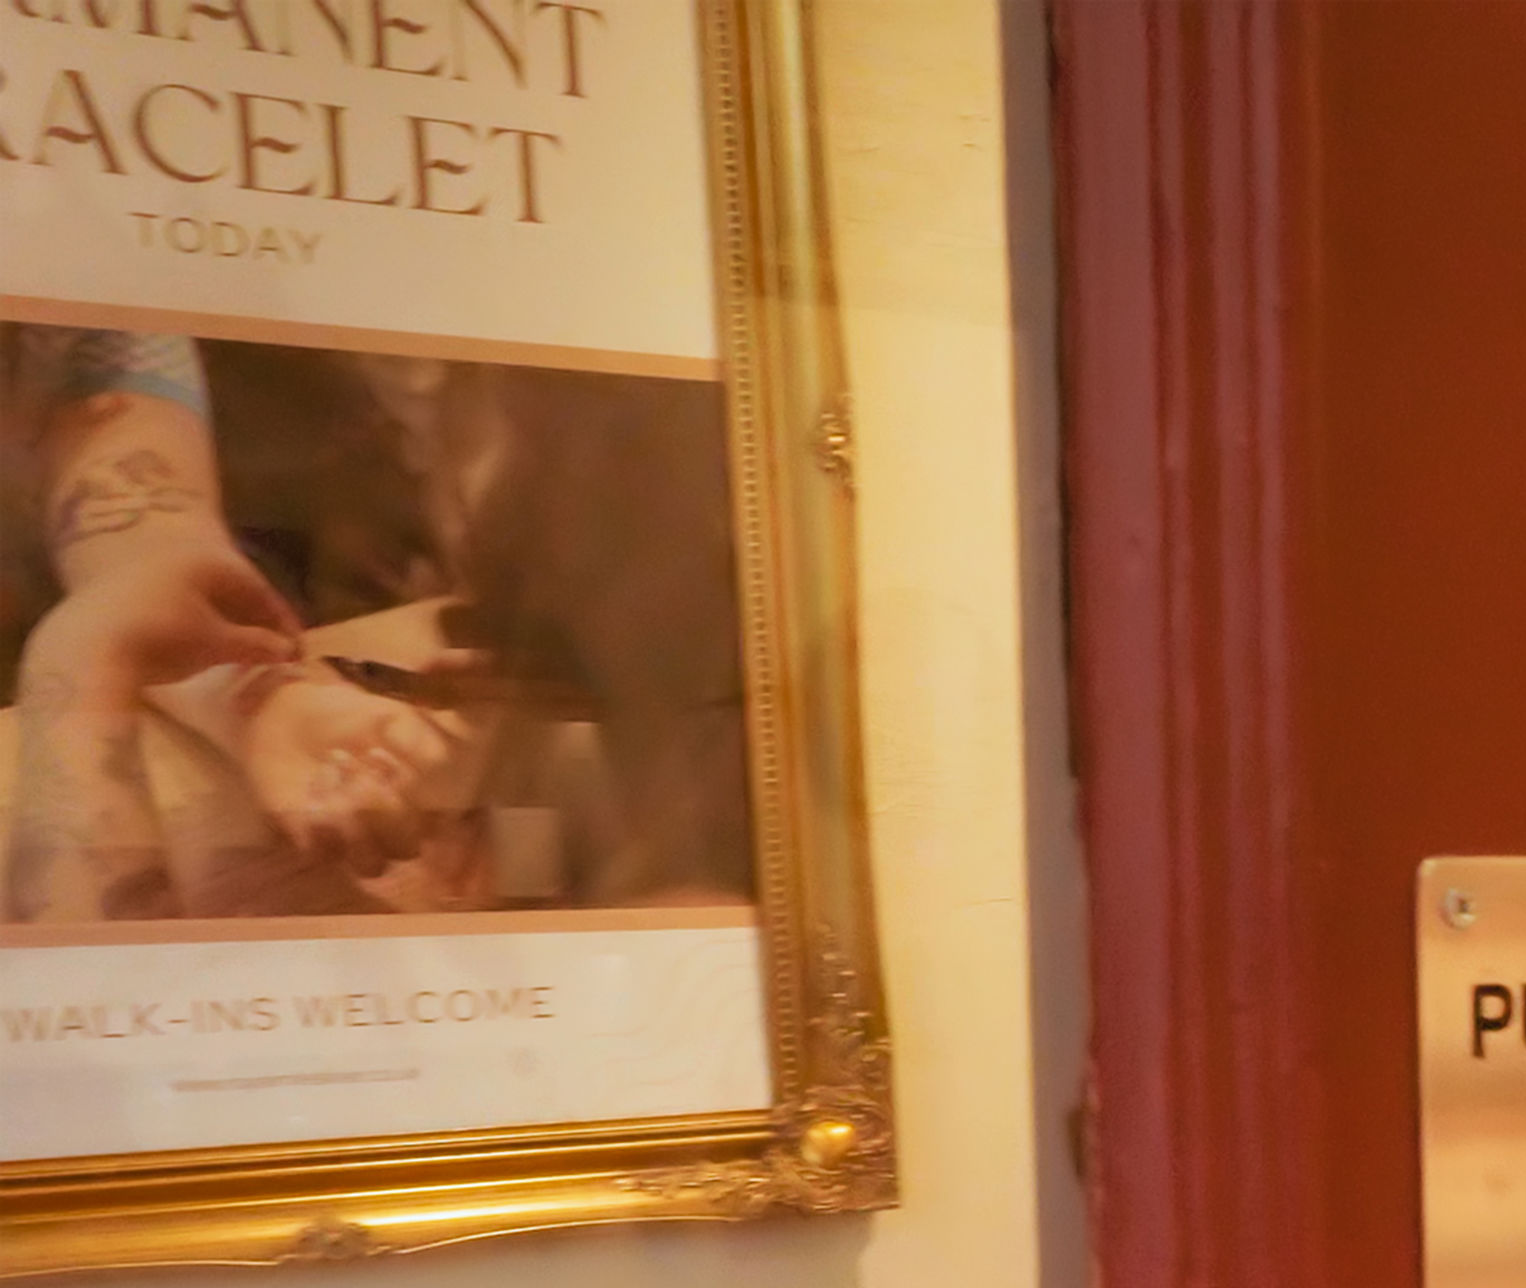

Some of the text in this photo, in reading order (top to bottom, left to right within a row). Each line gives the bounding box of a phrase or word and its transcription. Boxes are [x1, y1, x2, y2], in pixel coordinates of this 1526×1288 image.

[10, 0, 608, 99] ANENT
[0, 69, 562, 224] ACELET
[130, 212, 322, 265] TODAY
[1, 986, 556, 1043] WALK-INS WELCOME
